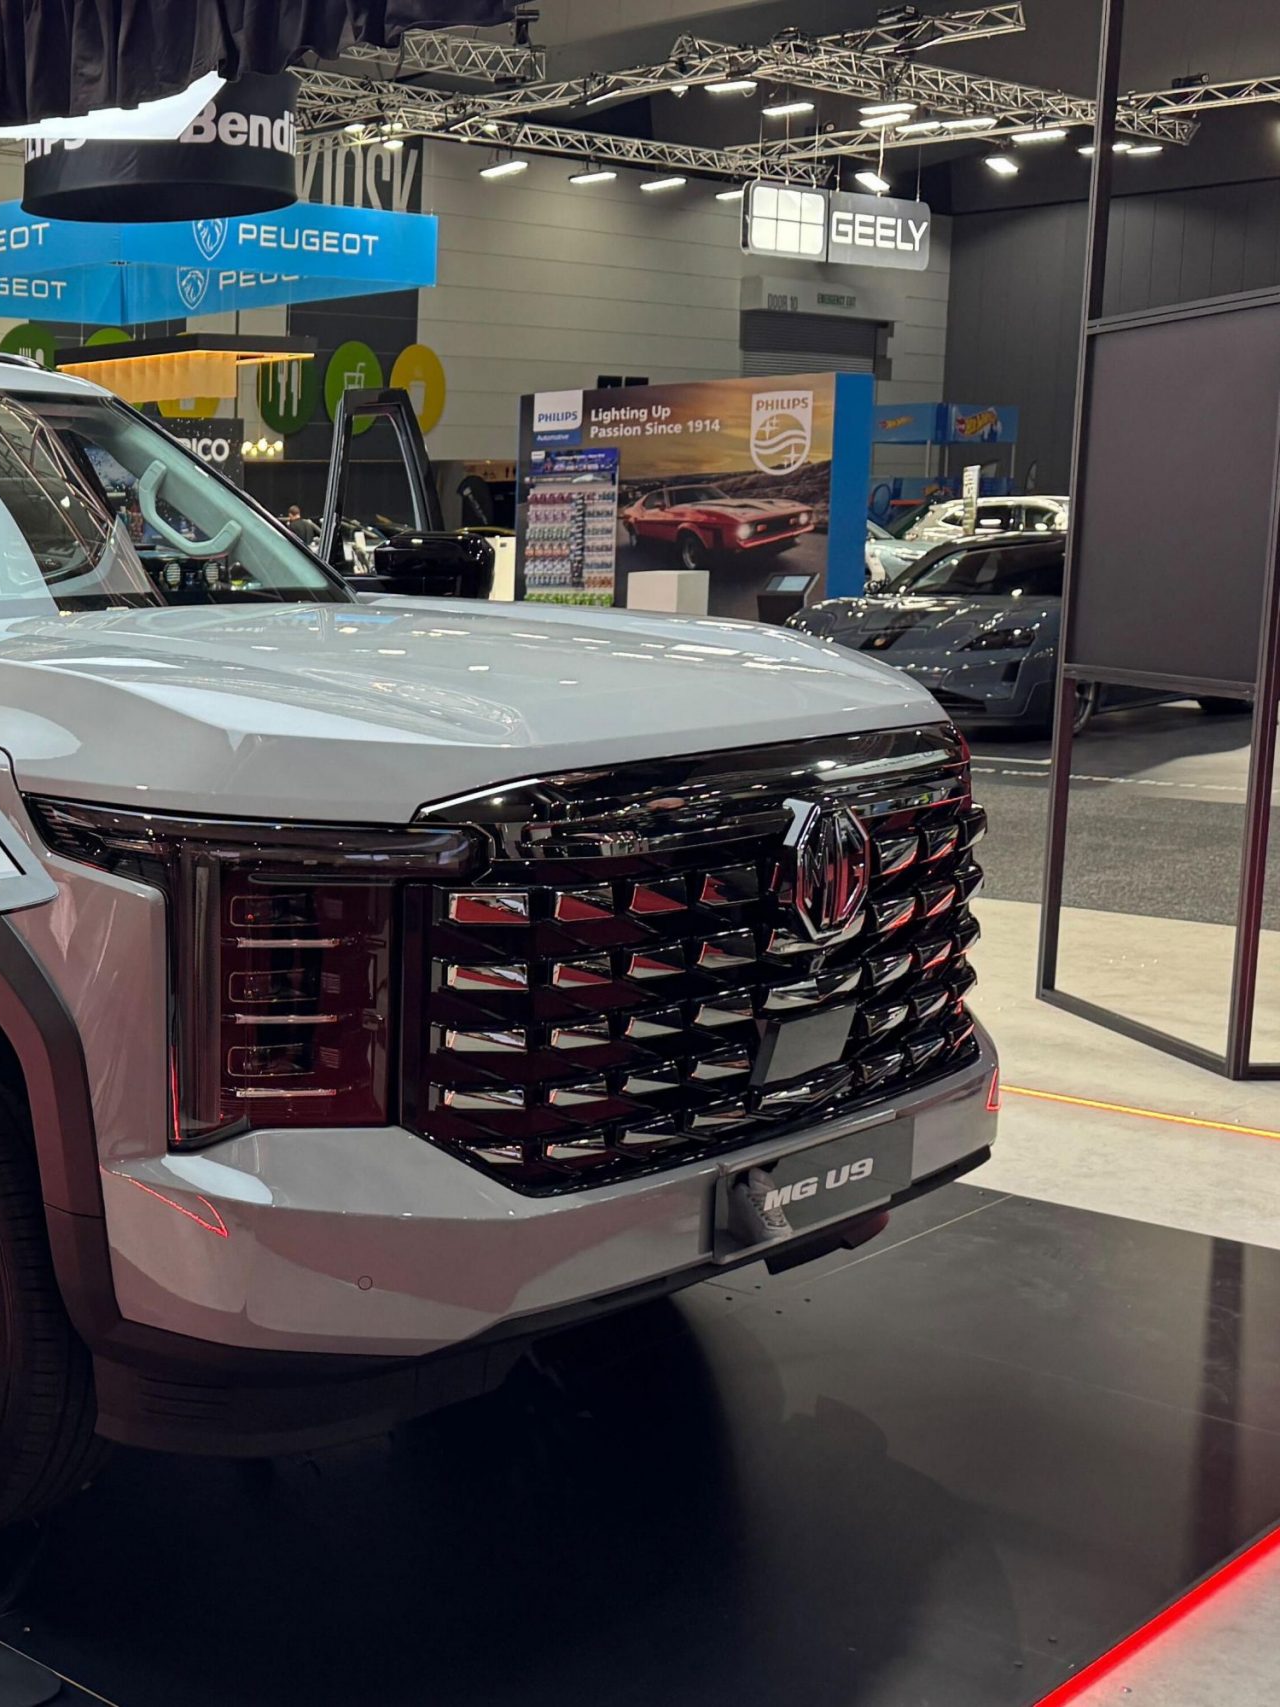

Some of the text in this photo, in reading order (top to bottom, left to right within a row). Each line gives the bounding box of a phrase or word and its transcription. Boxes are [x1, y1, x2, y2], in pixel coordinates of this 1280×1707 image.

[180, 100, 296, 156] Bendi
[238, 222, 379, 255] PEUGEOT
[831, 210, 929, 252] GEELY
[767, 292, 788, 311] DOOR
[756, 397, 809, 411] PHILIPS
[537, 411, 578, 423] PHILIPS
[591, 405, 671, 424] Lighting Up
[590, 419, 720, 438] Passion Since 1914
[763, 1157, 874, 1211] MG U9
